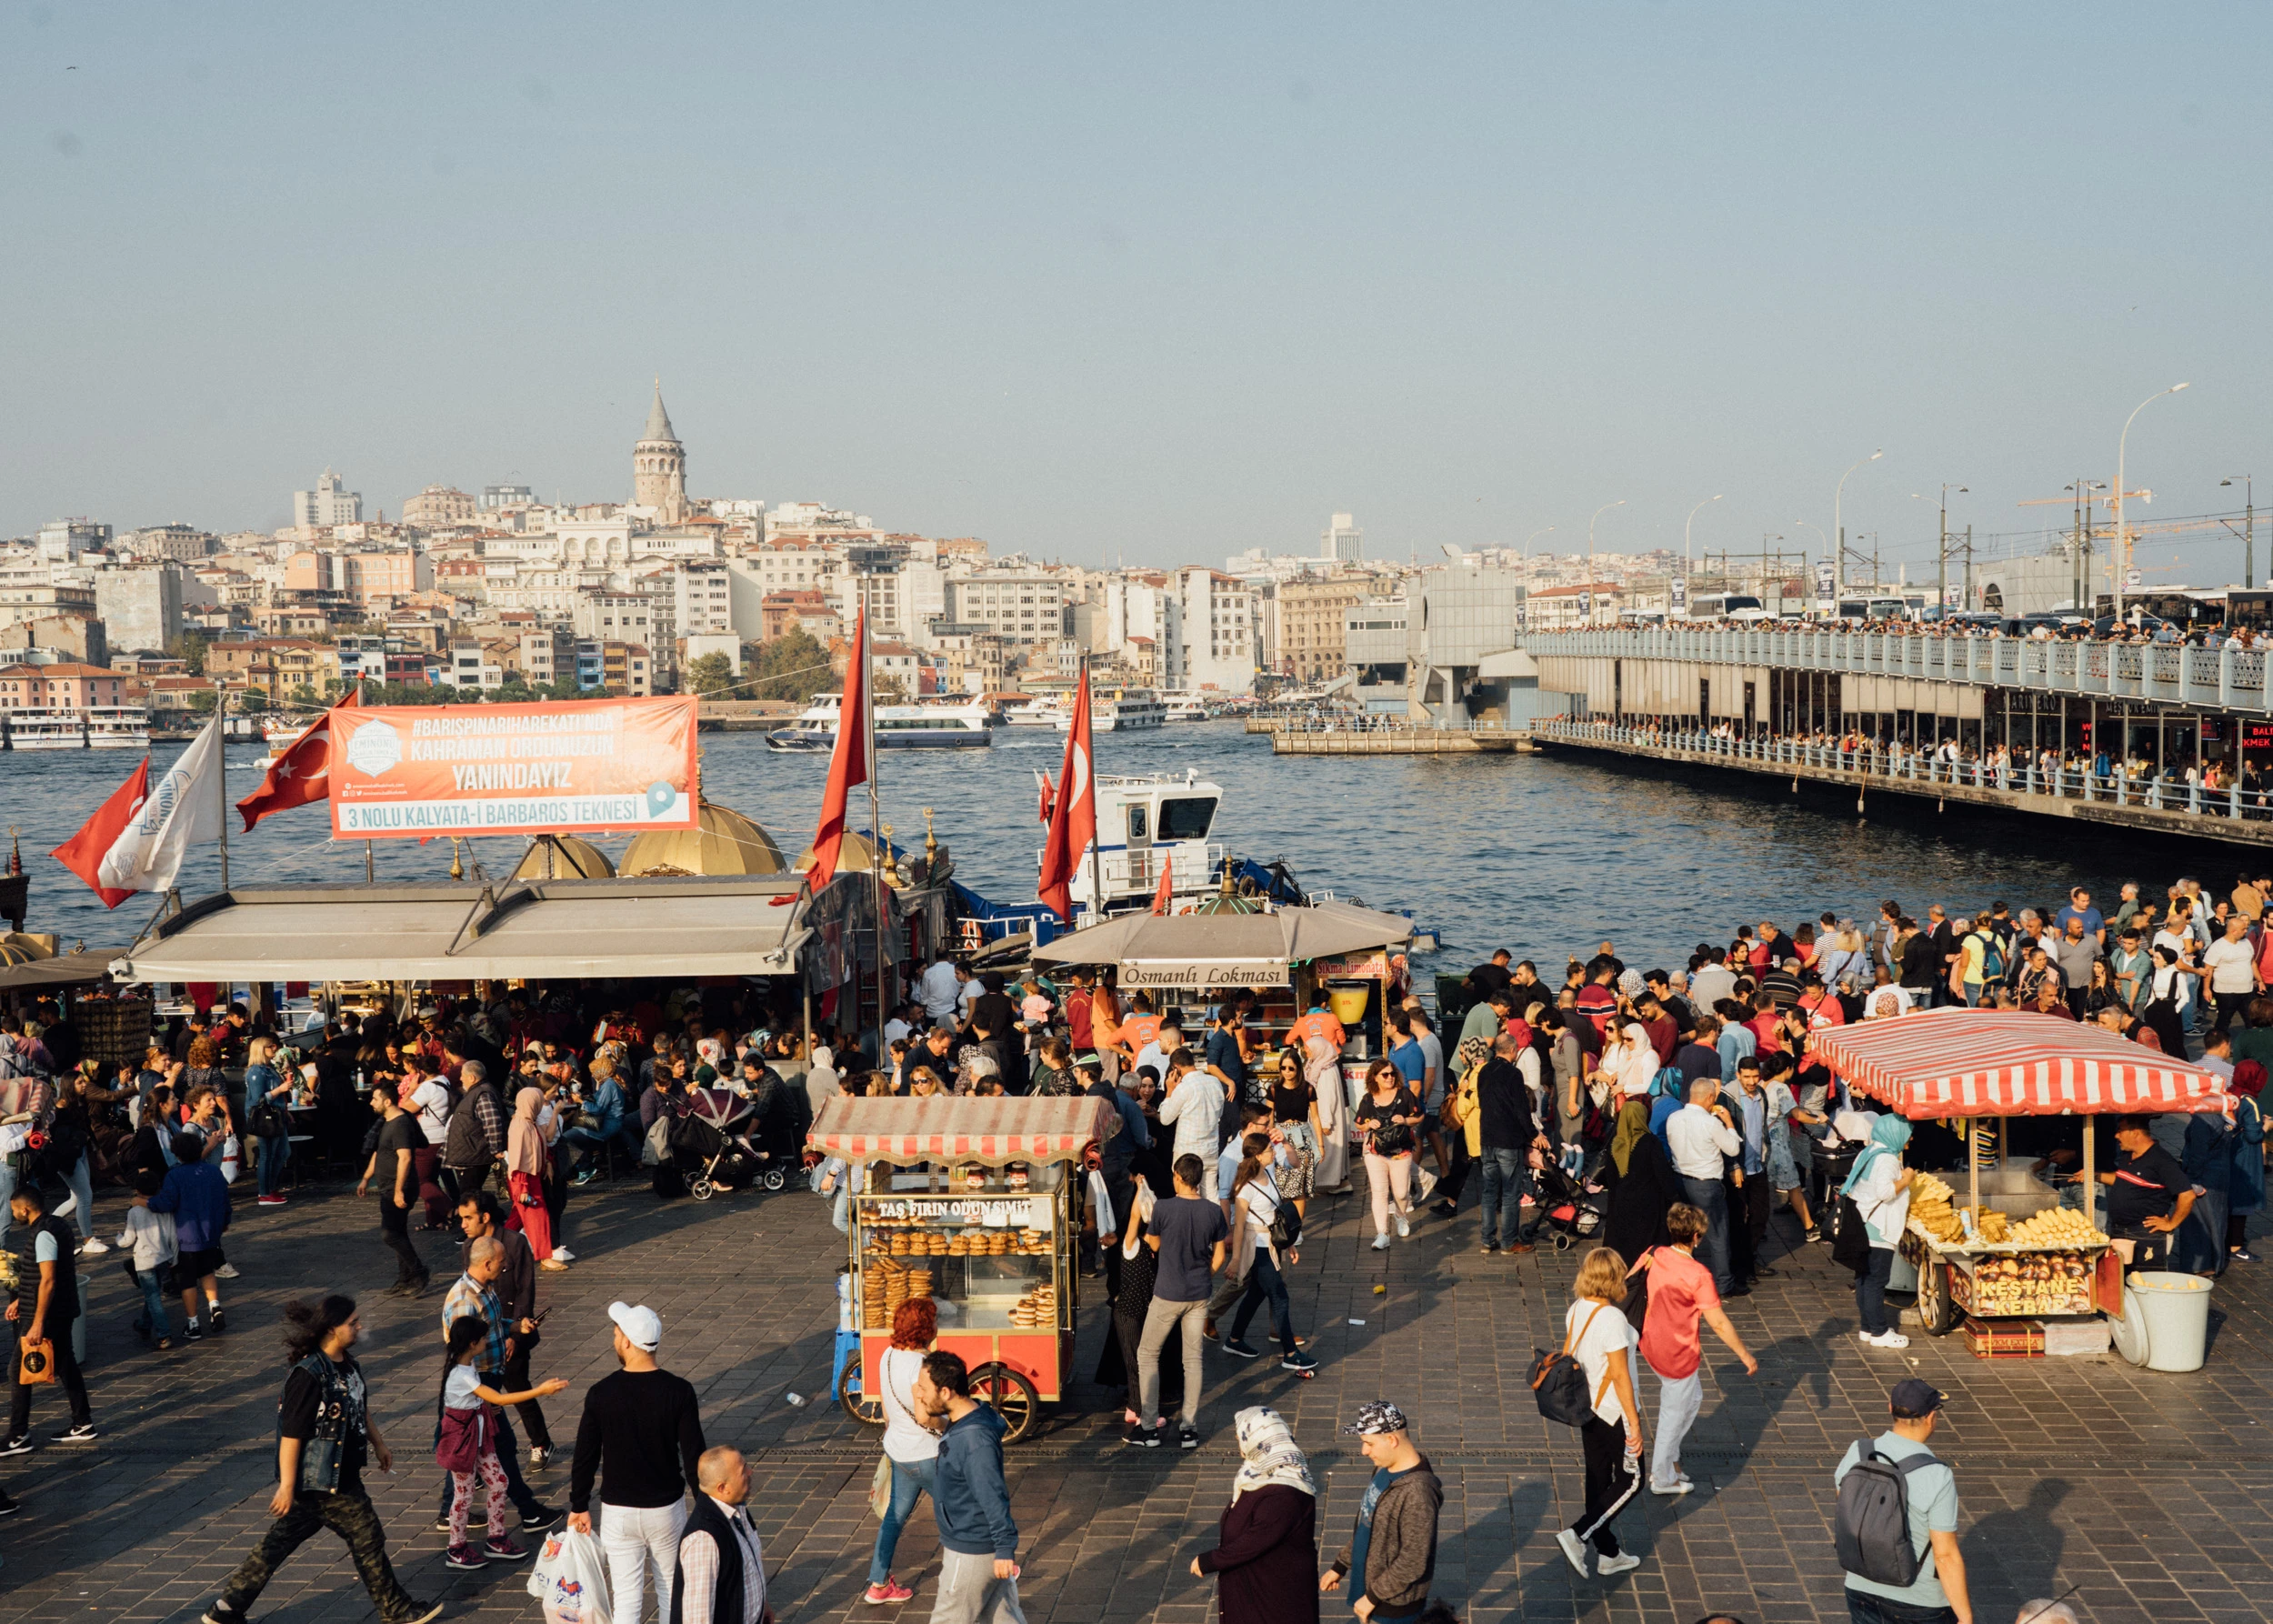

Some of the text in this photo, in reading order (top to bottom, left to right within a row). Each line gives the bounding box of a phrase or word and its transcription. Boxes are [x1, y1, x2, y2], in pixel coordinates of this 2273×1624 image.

[2003, 694, 2056, 710] ARINERO
[411, 735, 614, 761] KAHRAMAN ORDUMUZUN
[2242, 738, 2270, 747] KMEK
[452, 762, 573, 790] YANINDAYIZ
[348, 797, 636, 827] 3 NOLU KALYATA-İ BARBAROS TEKNESİ
[1125, 967, 1281, 984] Osmanlı Lokması
[1347, 960, 1384, 974] Limonata
[878, 1202, 906, 1218] TAŞ
[909, 1201, 948, 1217] FIRIN
[950, 1201, 991, 1216] ODUN
[1980, 1278, 2078, 1297] KESTANE
[1995, 1298, 2066, 1315] KEBAP
